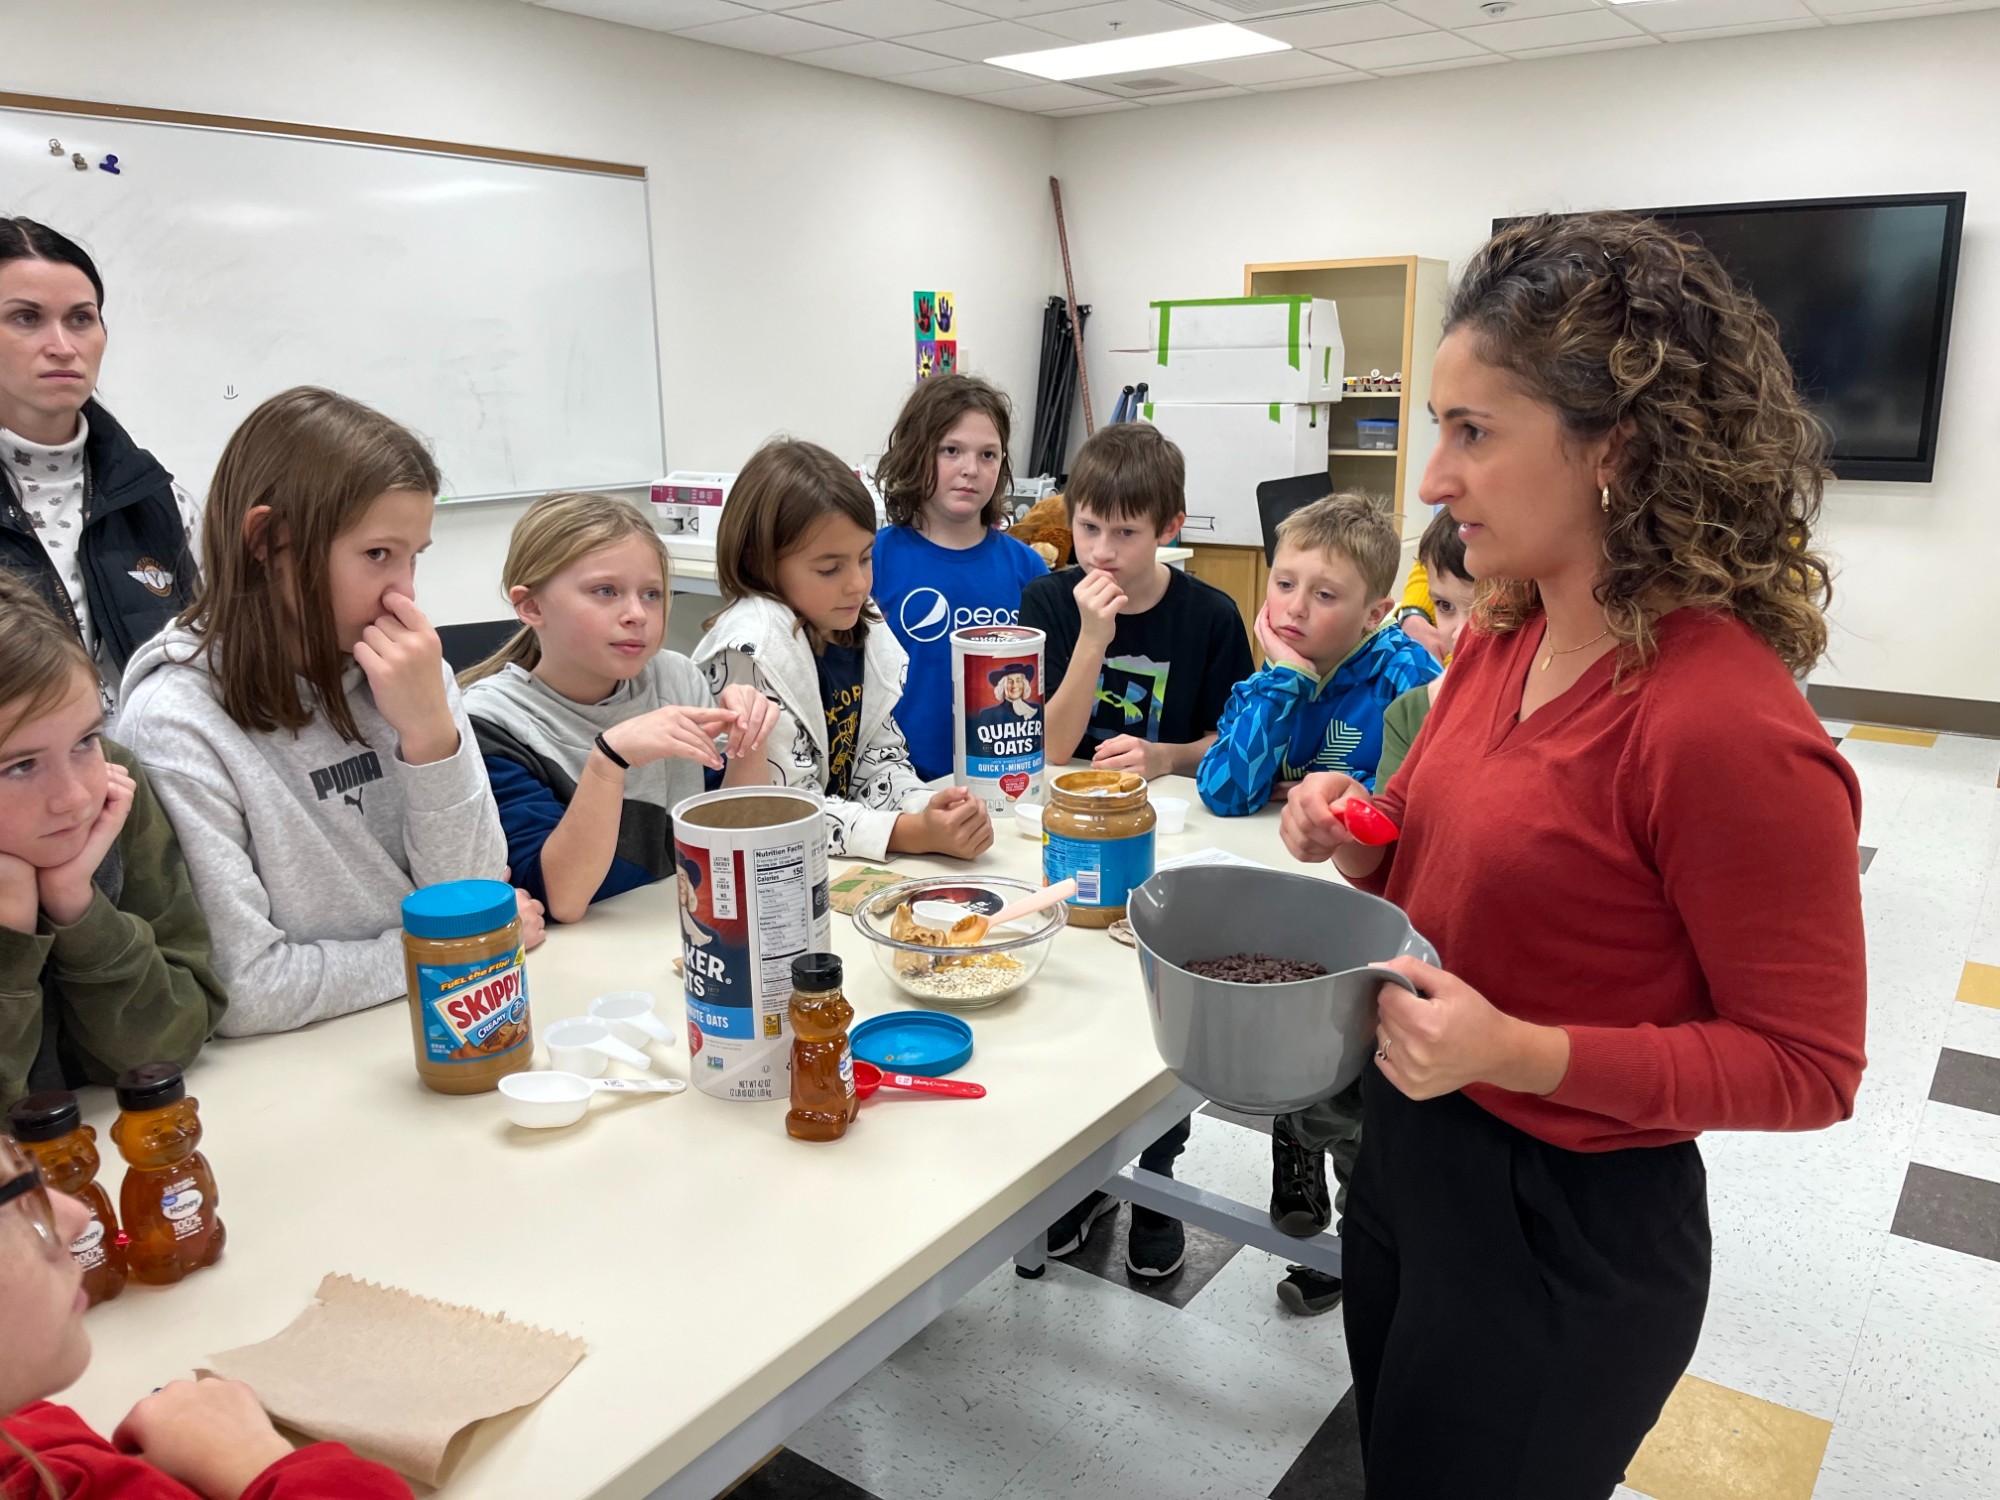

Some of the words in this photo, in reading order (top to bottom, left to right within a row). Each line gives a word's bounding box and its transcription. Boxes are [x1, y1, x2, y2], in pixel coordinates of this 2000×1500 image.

[954, 607, 1019, 629] peps
[977, 721, 1042, 743] QUAKER
[993, 738, 1033, 755] OATS
[309, 751, 383, 801] PUMA
[978, 763, 999, 773] QUICK
[1001, 761, 1031, 772] 1-MINUTE
[756, 848, 786, 857] Nutrition
[787, 844, 803, 853] Facts
[757, 874, 780, 882] Calories
[793, 866, 804, 876] 150
[685, 943, 725, 982] KER
[440, 977, 467, 992] FUEL
[467, 969, 488, 982] the
[488, 958, 511, 974] FUN!
[685, 970, 705, 997] TS
[447, 970, 520, 1030] SKIPPY
[477, 1012, 507, 1039] CREAMY
[706, 1013, 729, 1028] OATS
[738, 1080, 748, 1088] NET
[749, 1080, 757, 1088] WT
[758, 1080, 764, 1088] 42
[764, 1079, 771, 1087] OZ
[170, 1197, 199, 1216] Honey
[172, 1213, 203, 1232] 100%
